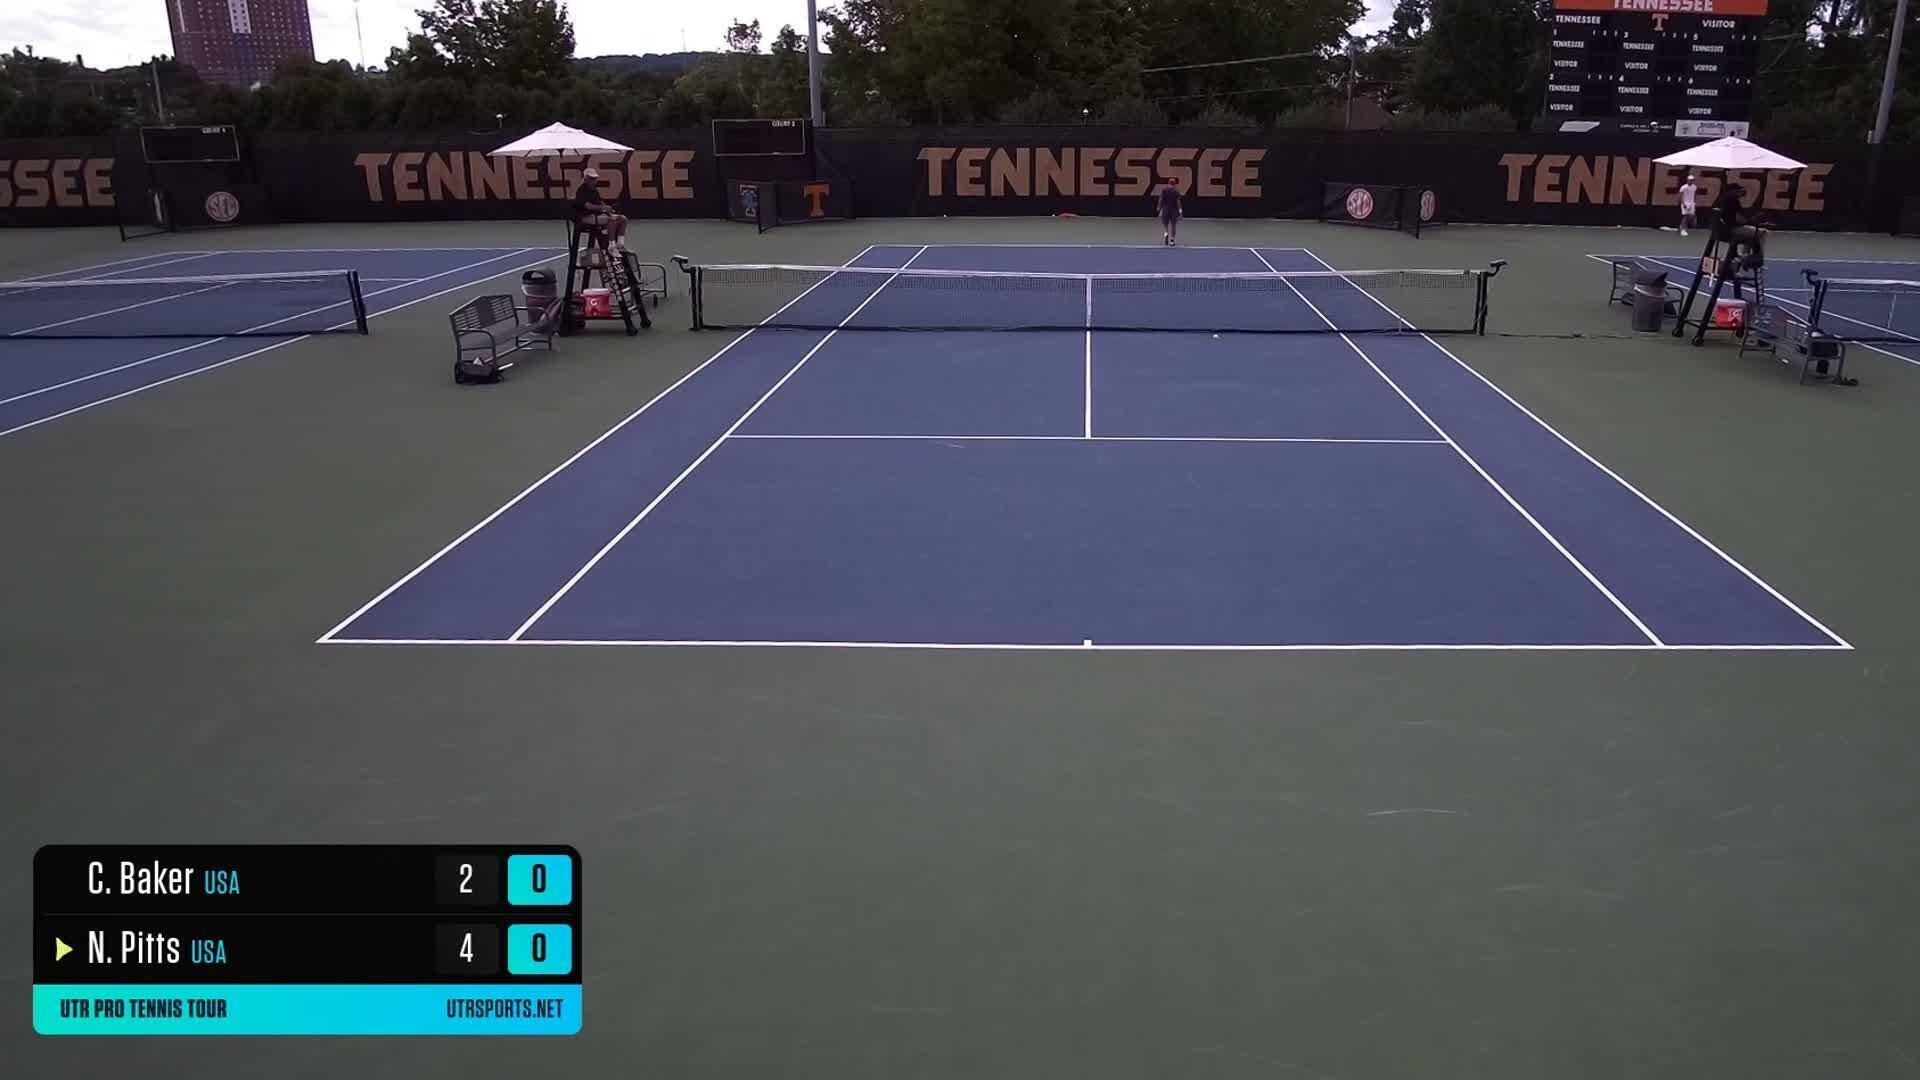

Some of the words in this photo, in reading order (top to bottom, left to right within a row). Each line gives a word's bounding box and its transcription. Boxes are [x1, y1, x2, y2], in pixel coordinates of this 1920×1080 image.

[1555, 15, 1601, 25] TENNESSEE
[1702, 20, 1736, 29] VISITOR
[354, 149, 696, 201] TENNESSEE
[916, 147, 1268, 199] TENNESSEE
[1498, 153, 1835, 212] TENNESSEE
[803, 183, 830, 217] T
